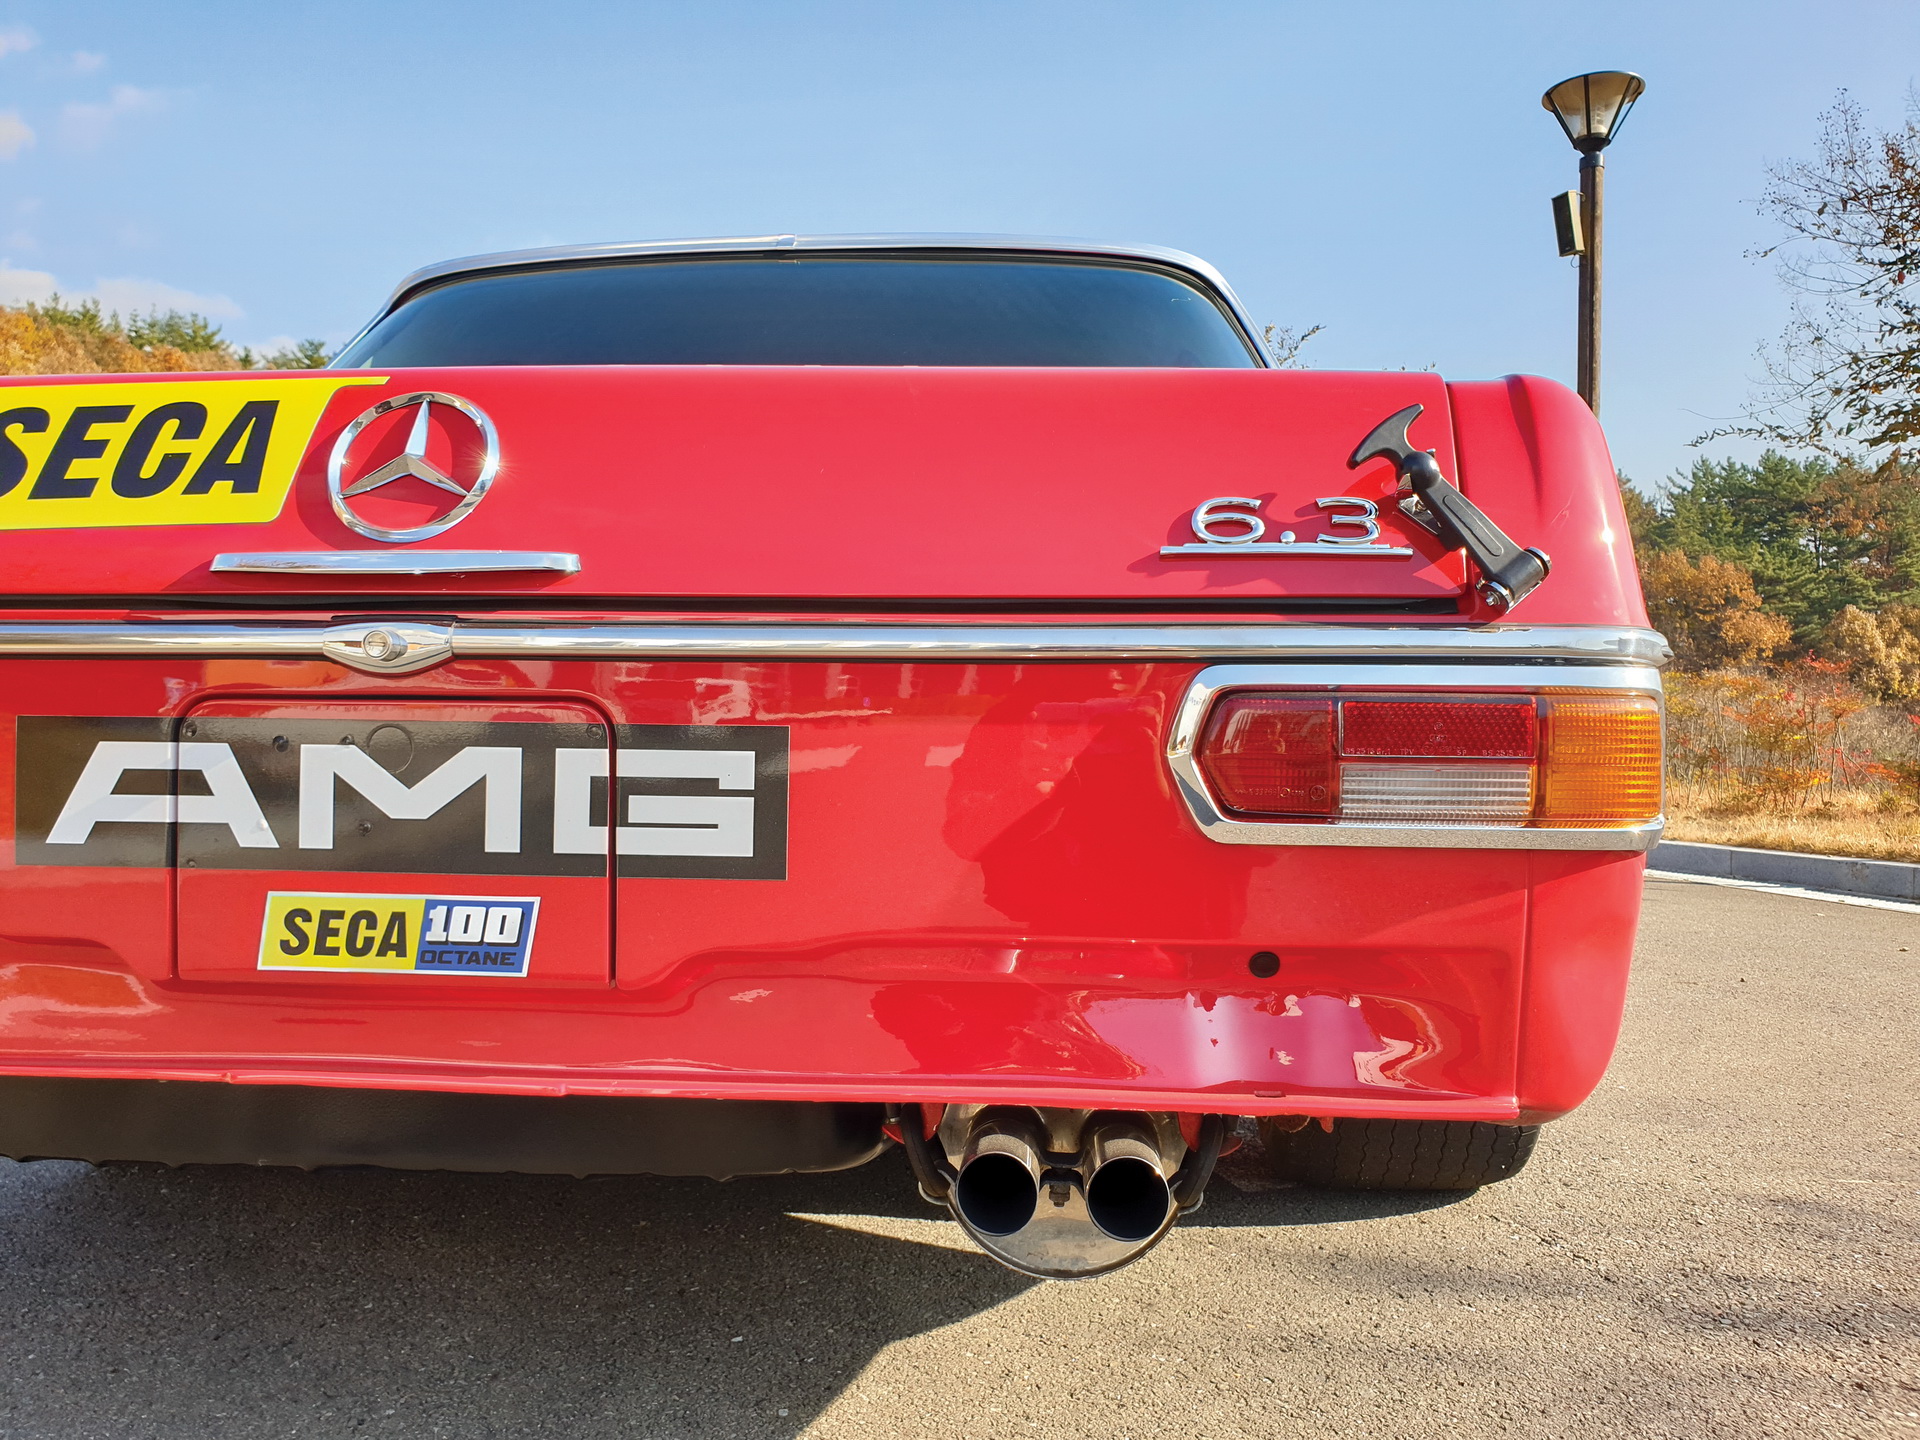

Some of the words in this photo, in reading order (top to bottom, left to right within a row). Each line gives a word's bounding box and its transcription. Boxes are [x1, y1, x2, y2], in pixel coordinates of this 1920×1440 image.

[0, 401, 280, 500] SECA
[1191, 497, 1380, 545] 6.3
[45, 741, 755, 857] AMG
[279, 908, 407, 957] SECA
[425, 905, 524, 946] 100
[420, 950, 517, 966] OCTANE
